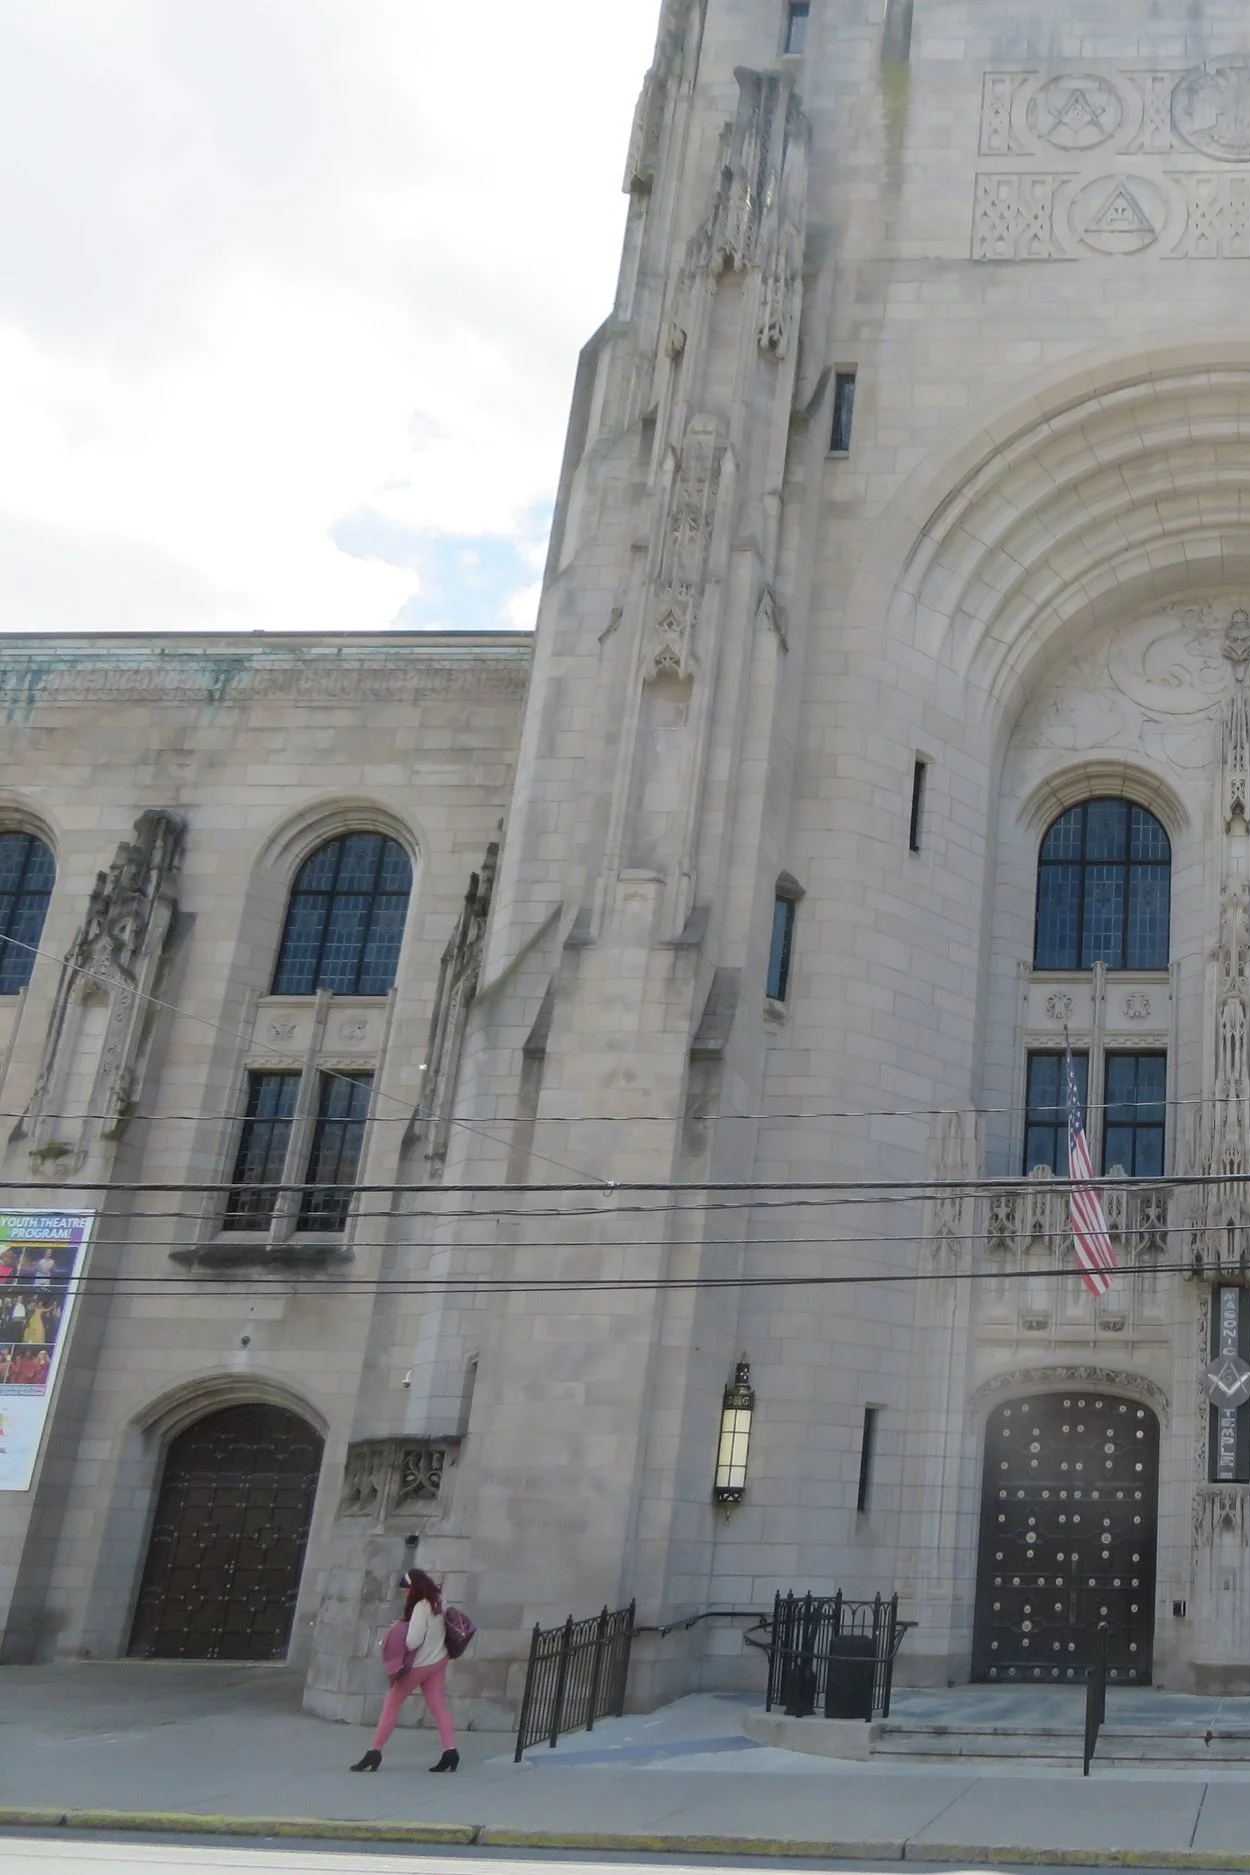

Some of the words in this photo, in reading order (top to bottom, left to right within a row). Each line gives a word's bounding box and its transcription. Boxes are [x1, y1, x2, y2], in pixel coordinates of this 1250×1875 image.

[0, 1217, 37, 1228] YOUTH
[40, 1216, 87, 1228] THEATRE
[11, 1228, 72, 1240] PROGRAM!
[1223, 1293, 1237, 1356] MASONIC
[1220, 1409, 1235, 1466] TEMPLE
